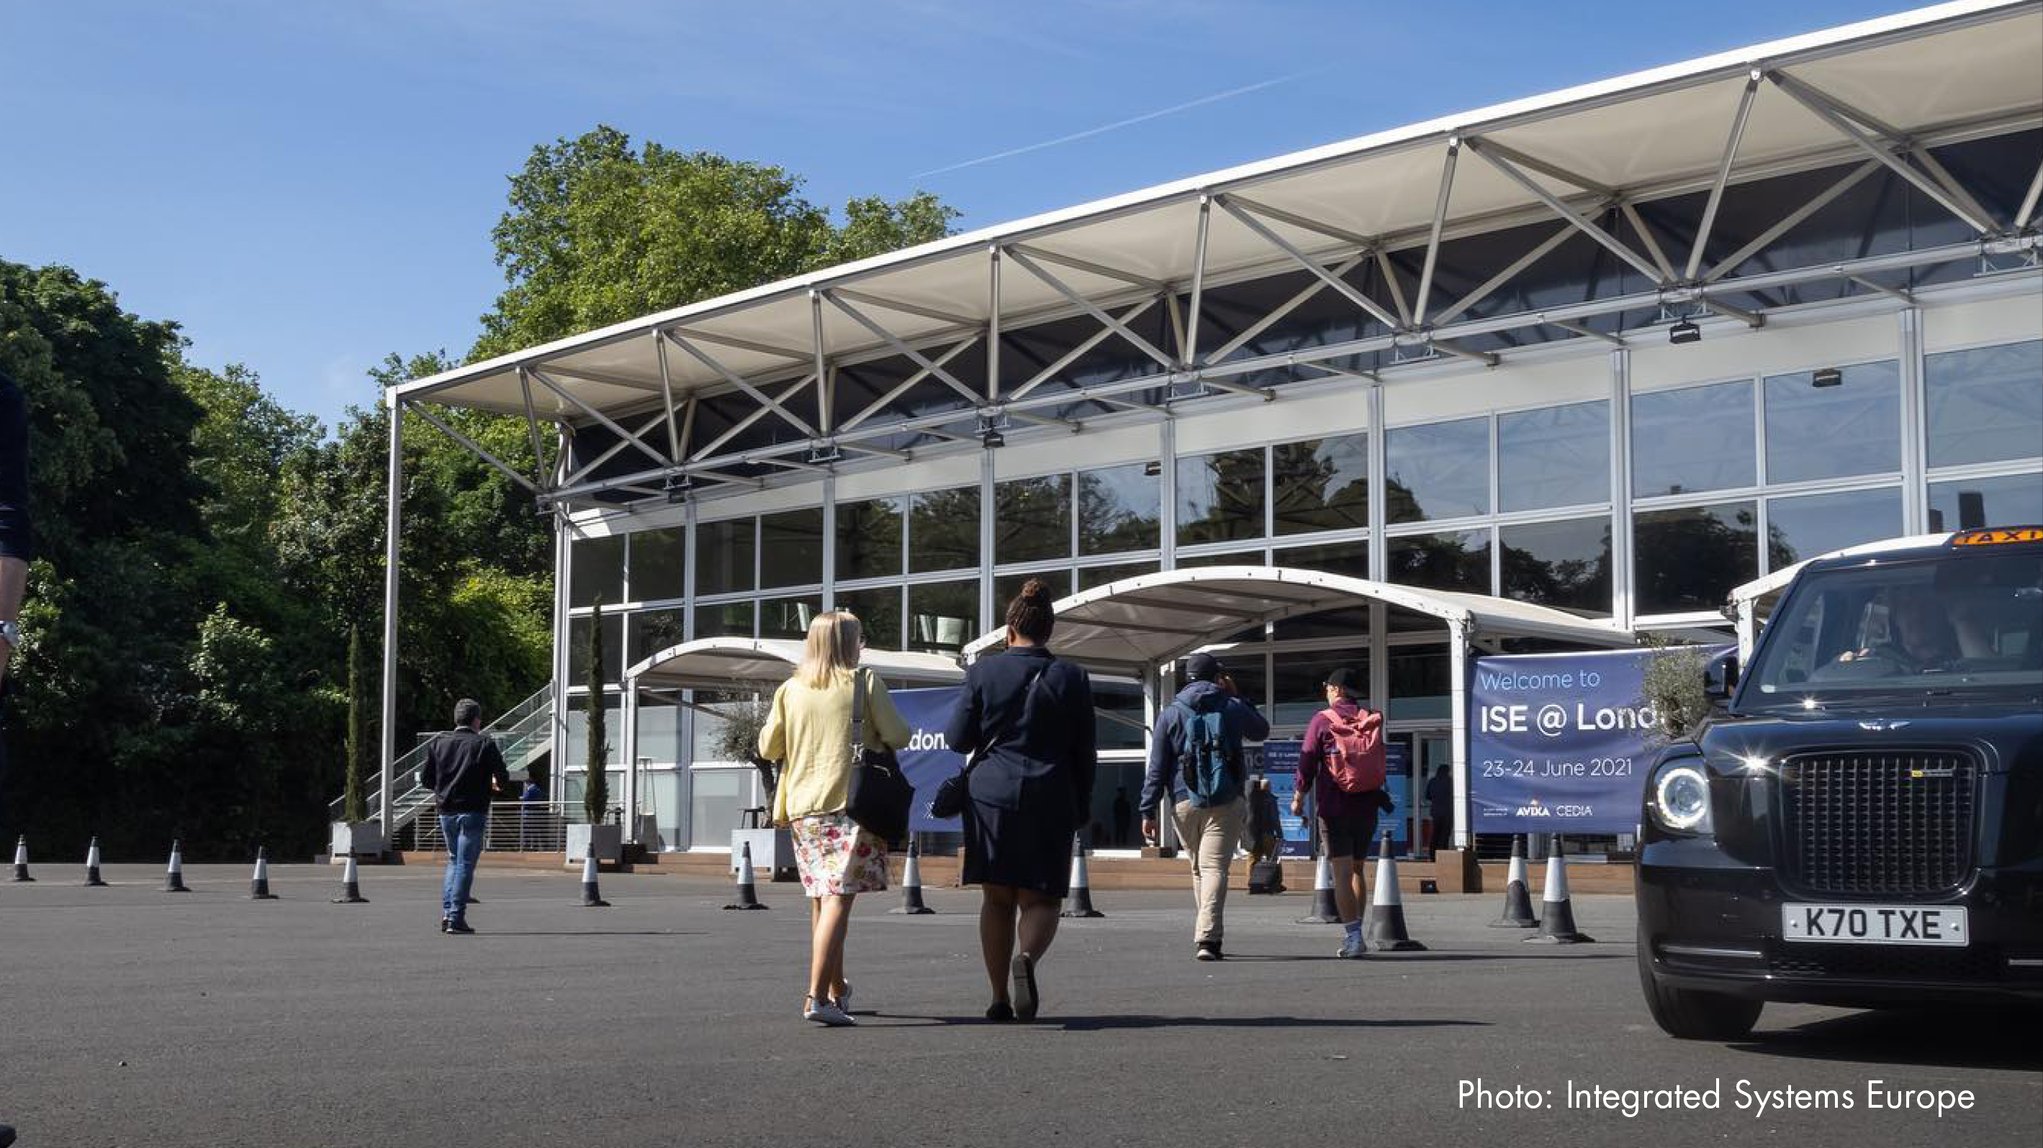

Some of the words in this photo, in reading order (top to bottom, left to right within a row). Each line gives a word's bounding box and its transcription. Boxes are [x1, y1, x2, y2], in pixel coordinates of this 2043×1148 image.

[1959, 530, 2036, 543] TAXI
[1480, 671, 1573, 690] Welcome
[1579, 669, 1601, 687] to
[1481, 704, 1529, 733] ISE
[1536, 703, 1567, 737] @
[1577, 700, 1664, 731] Lond
[1482, 759, 1535, 778] 23-24
[1540, 760, 1586, 776] June
[1590, 758, 1632, 776] 2021
[1515, 806, 1551, 817] AVIXA
[1556, 805, 1593, 817] CEDIA
[1806, 908, 1868, 937] K70
[1877, 909, 1942, 940] TXE
